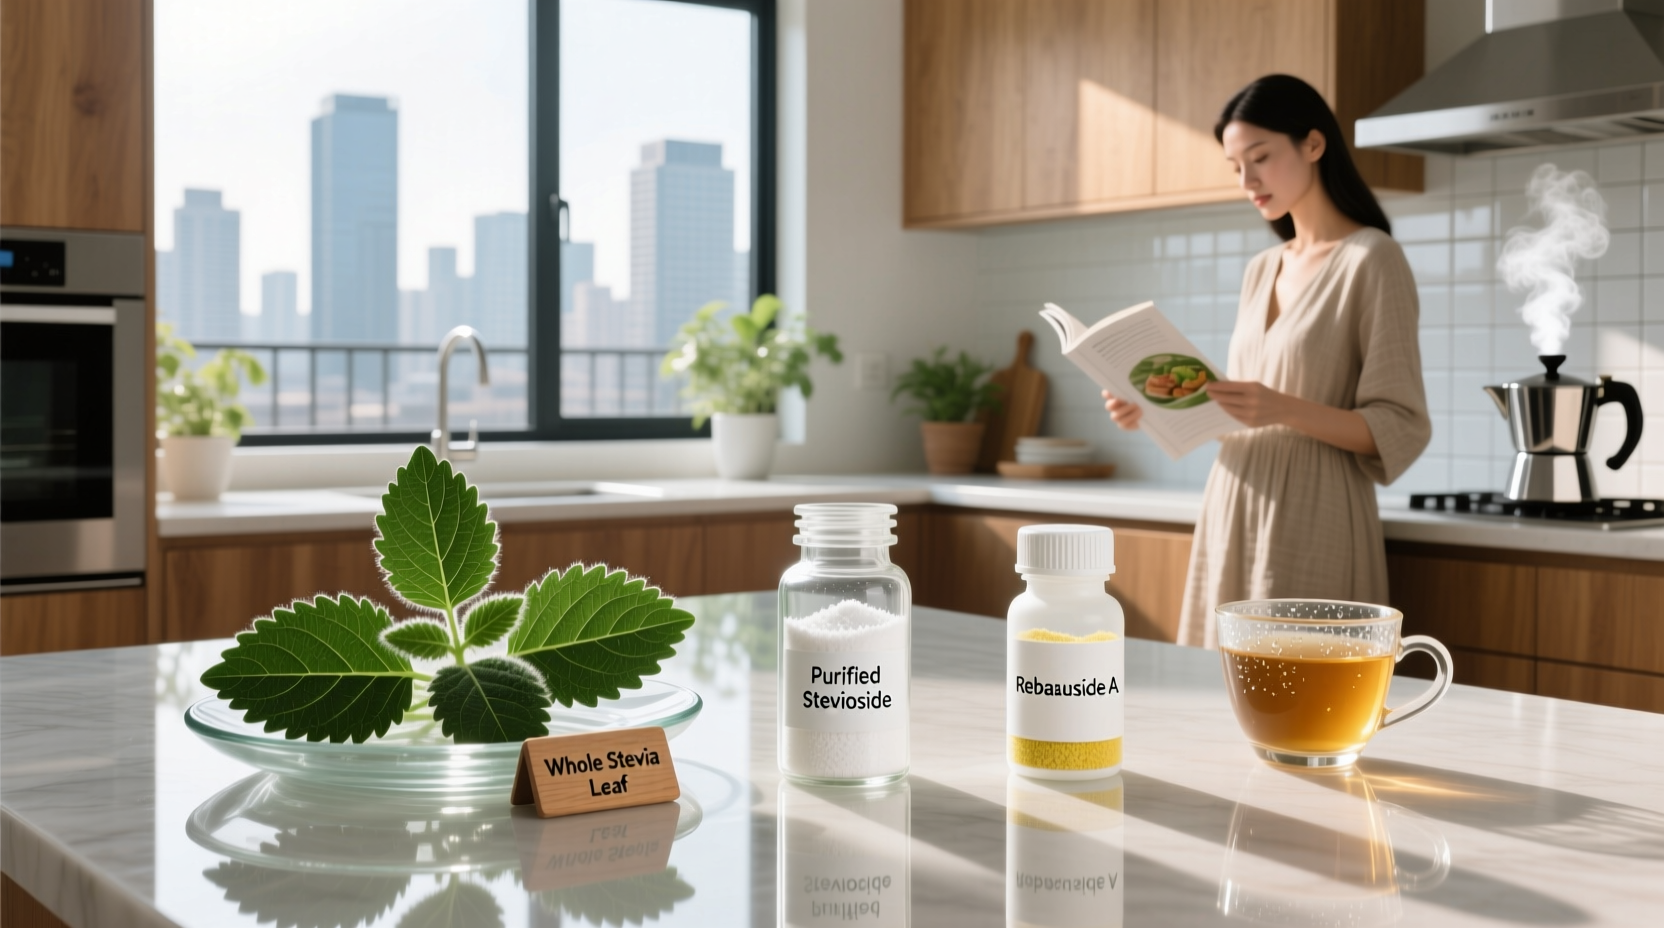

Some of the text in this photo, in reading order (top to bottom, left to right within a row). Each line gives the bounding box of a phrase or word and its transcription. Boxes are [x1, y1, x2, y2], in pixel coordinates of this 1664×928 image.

[811, 665, 881, 685] Purified
[1108, 676, 1119, 694] A
[802, 690, 892, 709] Stevioside
[544, 747, 660, 777] Whole Stevia
[589, 774, 629, 797] Leaf
